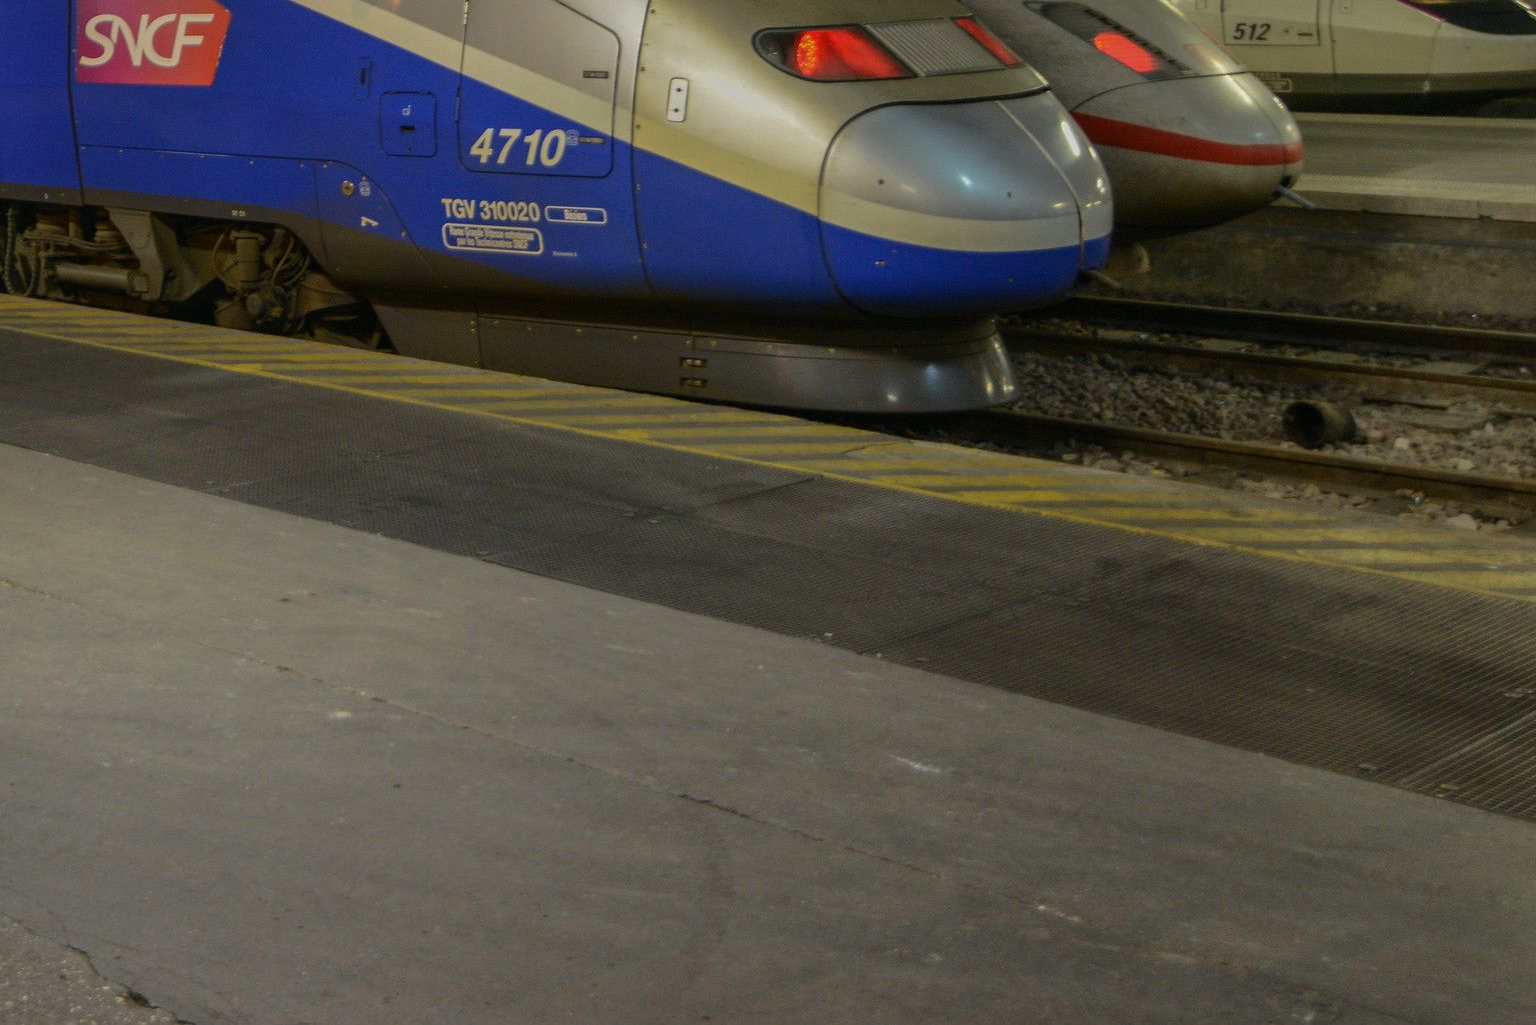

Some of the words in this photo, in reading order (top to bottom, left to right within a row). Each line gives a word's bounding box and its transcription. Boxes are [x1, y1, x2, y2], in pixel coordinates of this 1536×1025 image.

[79, 12, 215, 67] SNCF
[1232, 22, 1271, 41] 512
[469, 127, 566, 167] 4710
[441, 198, 476, 219] TGV
[479, 200, 541, 222] 310020
